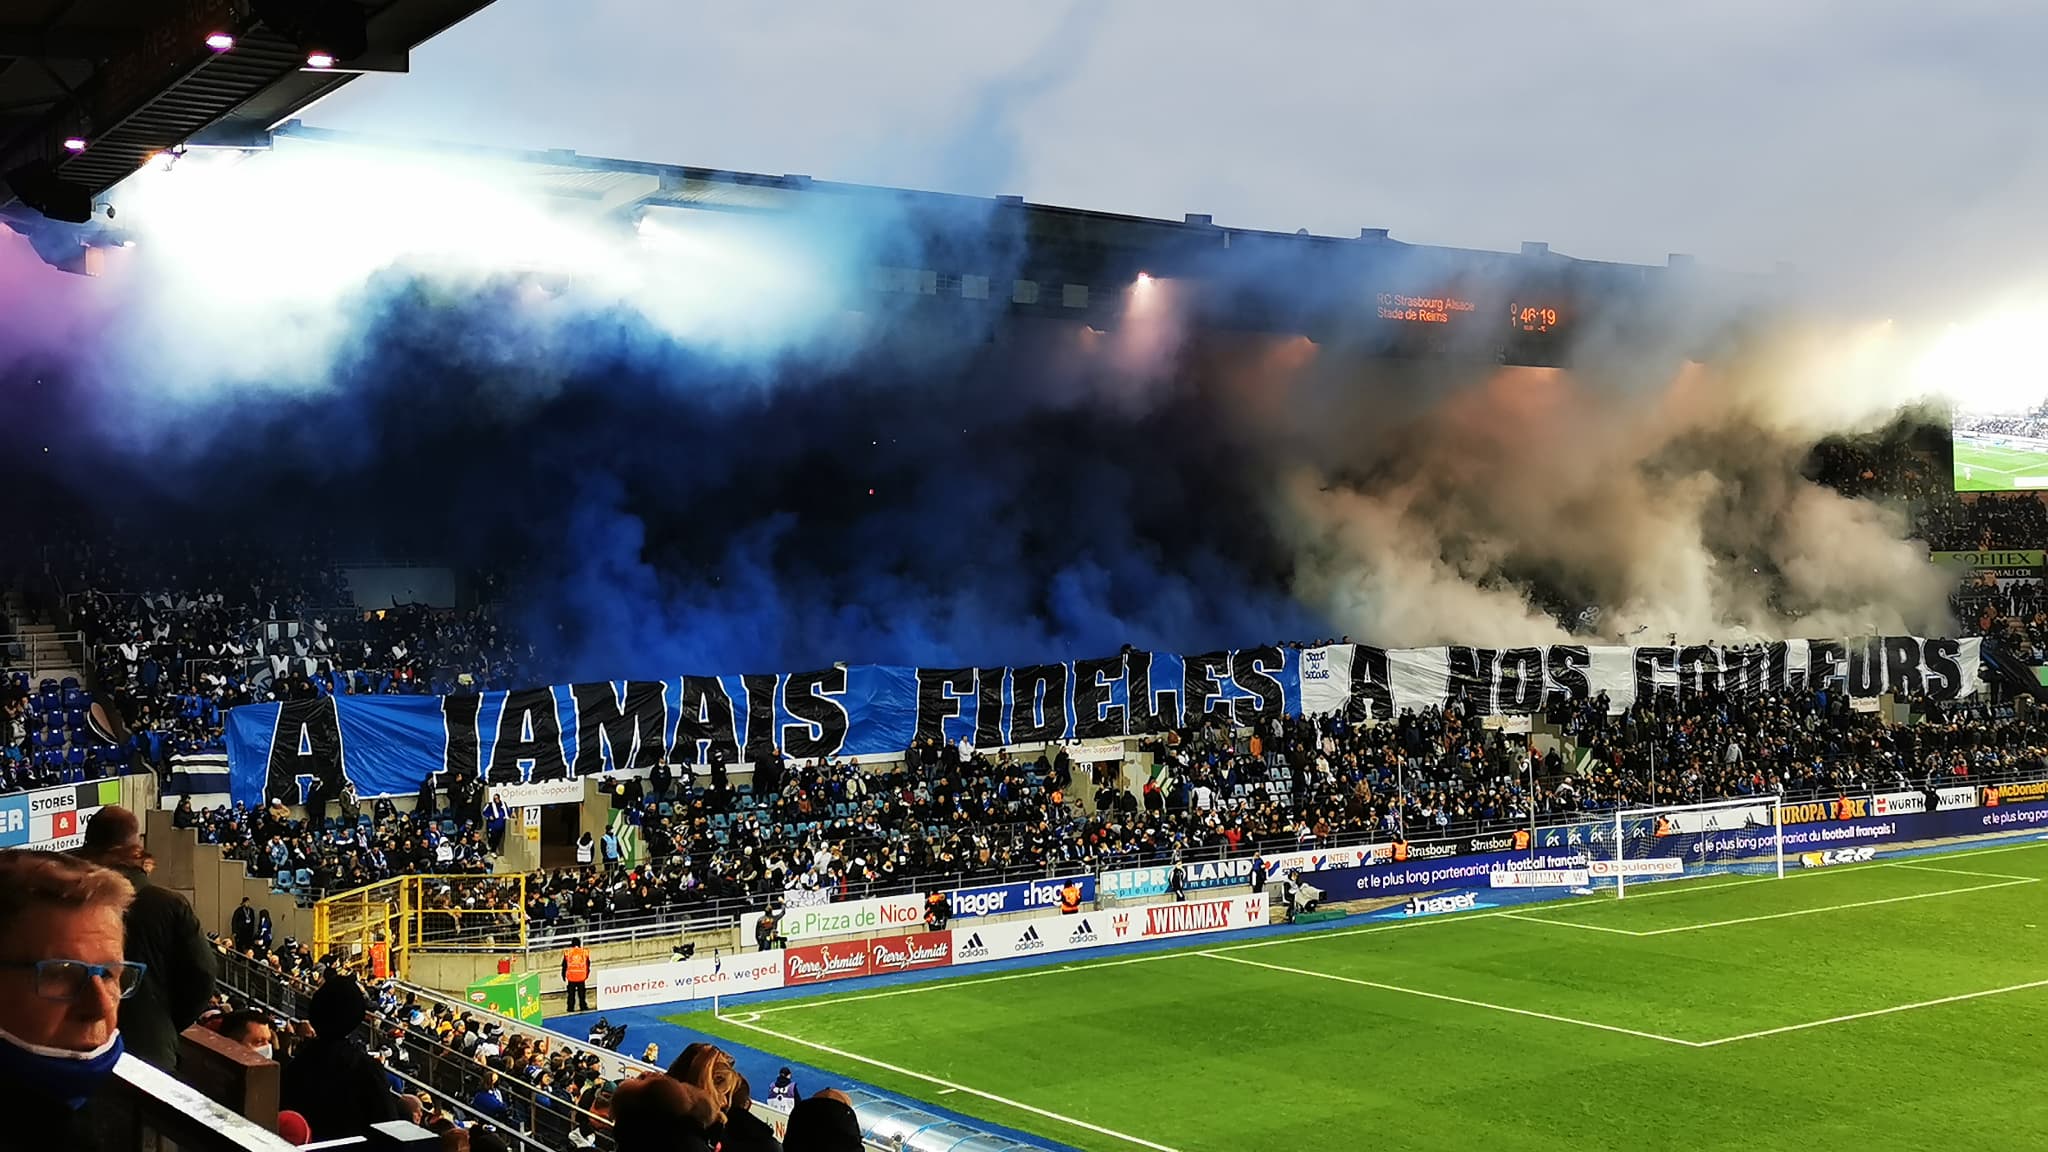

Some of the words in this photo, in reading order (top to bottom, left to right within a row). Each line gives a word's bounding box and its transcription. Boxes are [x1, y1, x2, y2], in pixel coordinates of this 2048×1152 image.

[1377, 293, 1391, 304] RC
[1394, 295, 1443, 311] Strasbourg
[1445, 298, 1475, 311] Alsace
[1377, 306, 1403, 319] Stade
[1405, 309, 1417, 320] de
[1419, 309, 1448, 322] Reims
[1952, 553, 2031, 565] SOFITEX
[264, 695, 352, 804] A
[434, 665, 849, 788] JAMAIS
[914, 647, 1286, 750] FIDELES
[1348, 644, 1396, 720] A
[1444, 646, 1592, 715] NOS
[1082, 764, 1092, 773] 18
[501, 788, 538, 799] Opticien
[541, 784, 579, 797] Supporter
[31, 794, 75, 812] STORES
[526, 808, 539, 820] 17
[1992, 812, 2000, 824] le
[2000, 811, 2017, 825] plus
[2017, 810, 2035, 823] long
[1705, 839, 1714, 852] le
[1716, 838, 1736, 853] plus
[1736, 837, 1757, 851] long
[1809, 829, 1821, 841] du
[1822, 826, 1855, 841] football
[1856, 823, 1891, 838] français
[1281, 857, 1305, 868] INTER
[1327, 852, 1350, 863] INTER
[1357, 878, 1368, 889] et
[1371, 876, 1380, 888] le
[1383, 873, 1405, 889] plus
[1406, 869, 1429, 885] long
[1432, 863, 1490, 883] partenariat
[1492, 860, 1505, 872] du
[1507, 856, 1546, 871] football
[1547, 853, 1586, 869] français
[780, 918, 801, 936] La
[805, 912, 850, 934] Pizza
[855, 906, 876, 928] de
[880, 903, 918, 924] Nico
[1151, 901, 1226, 934] WINAMAX
[1014, 940, 1044, 951] adidas
[1069, 933, 1098, 944] adidas
[873, 943, 906, 967] Pierre
[904, 938, 949, 963] Schmidt
[958, 947, 989, 959] adidas
[788, 954, 821, 977] Pierre
[820, 947, 867, 974] Schmidt
[604, 979, 669, 996] numerize.
[733, 963, 781, 981] weged.
